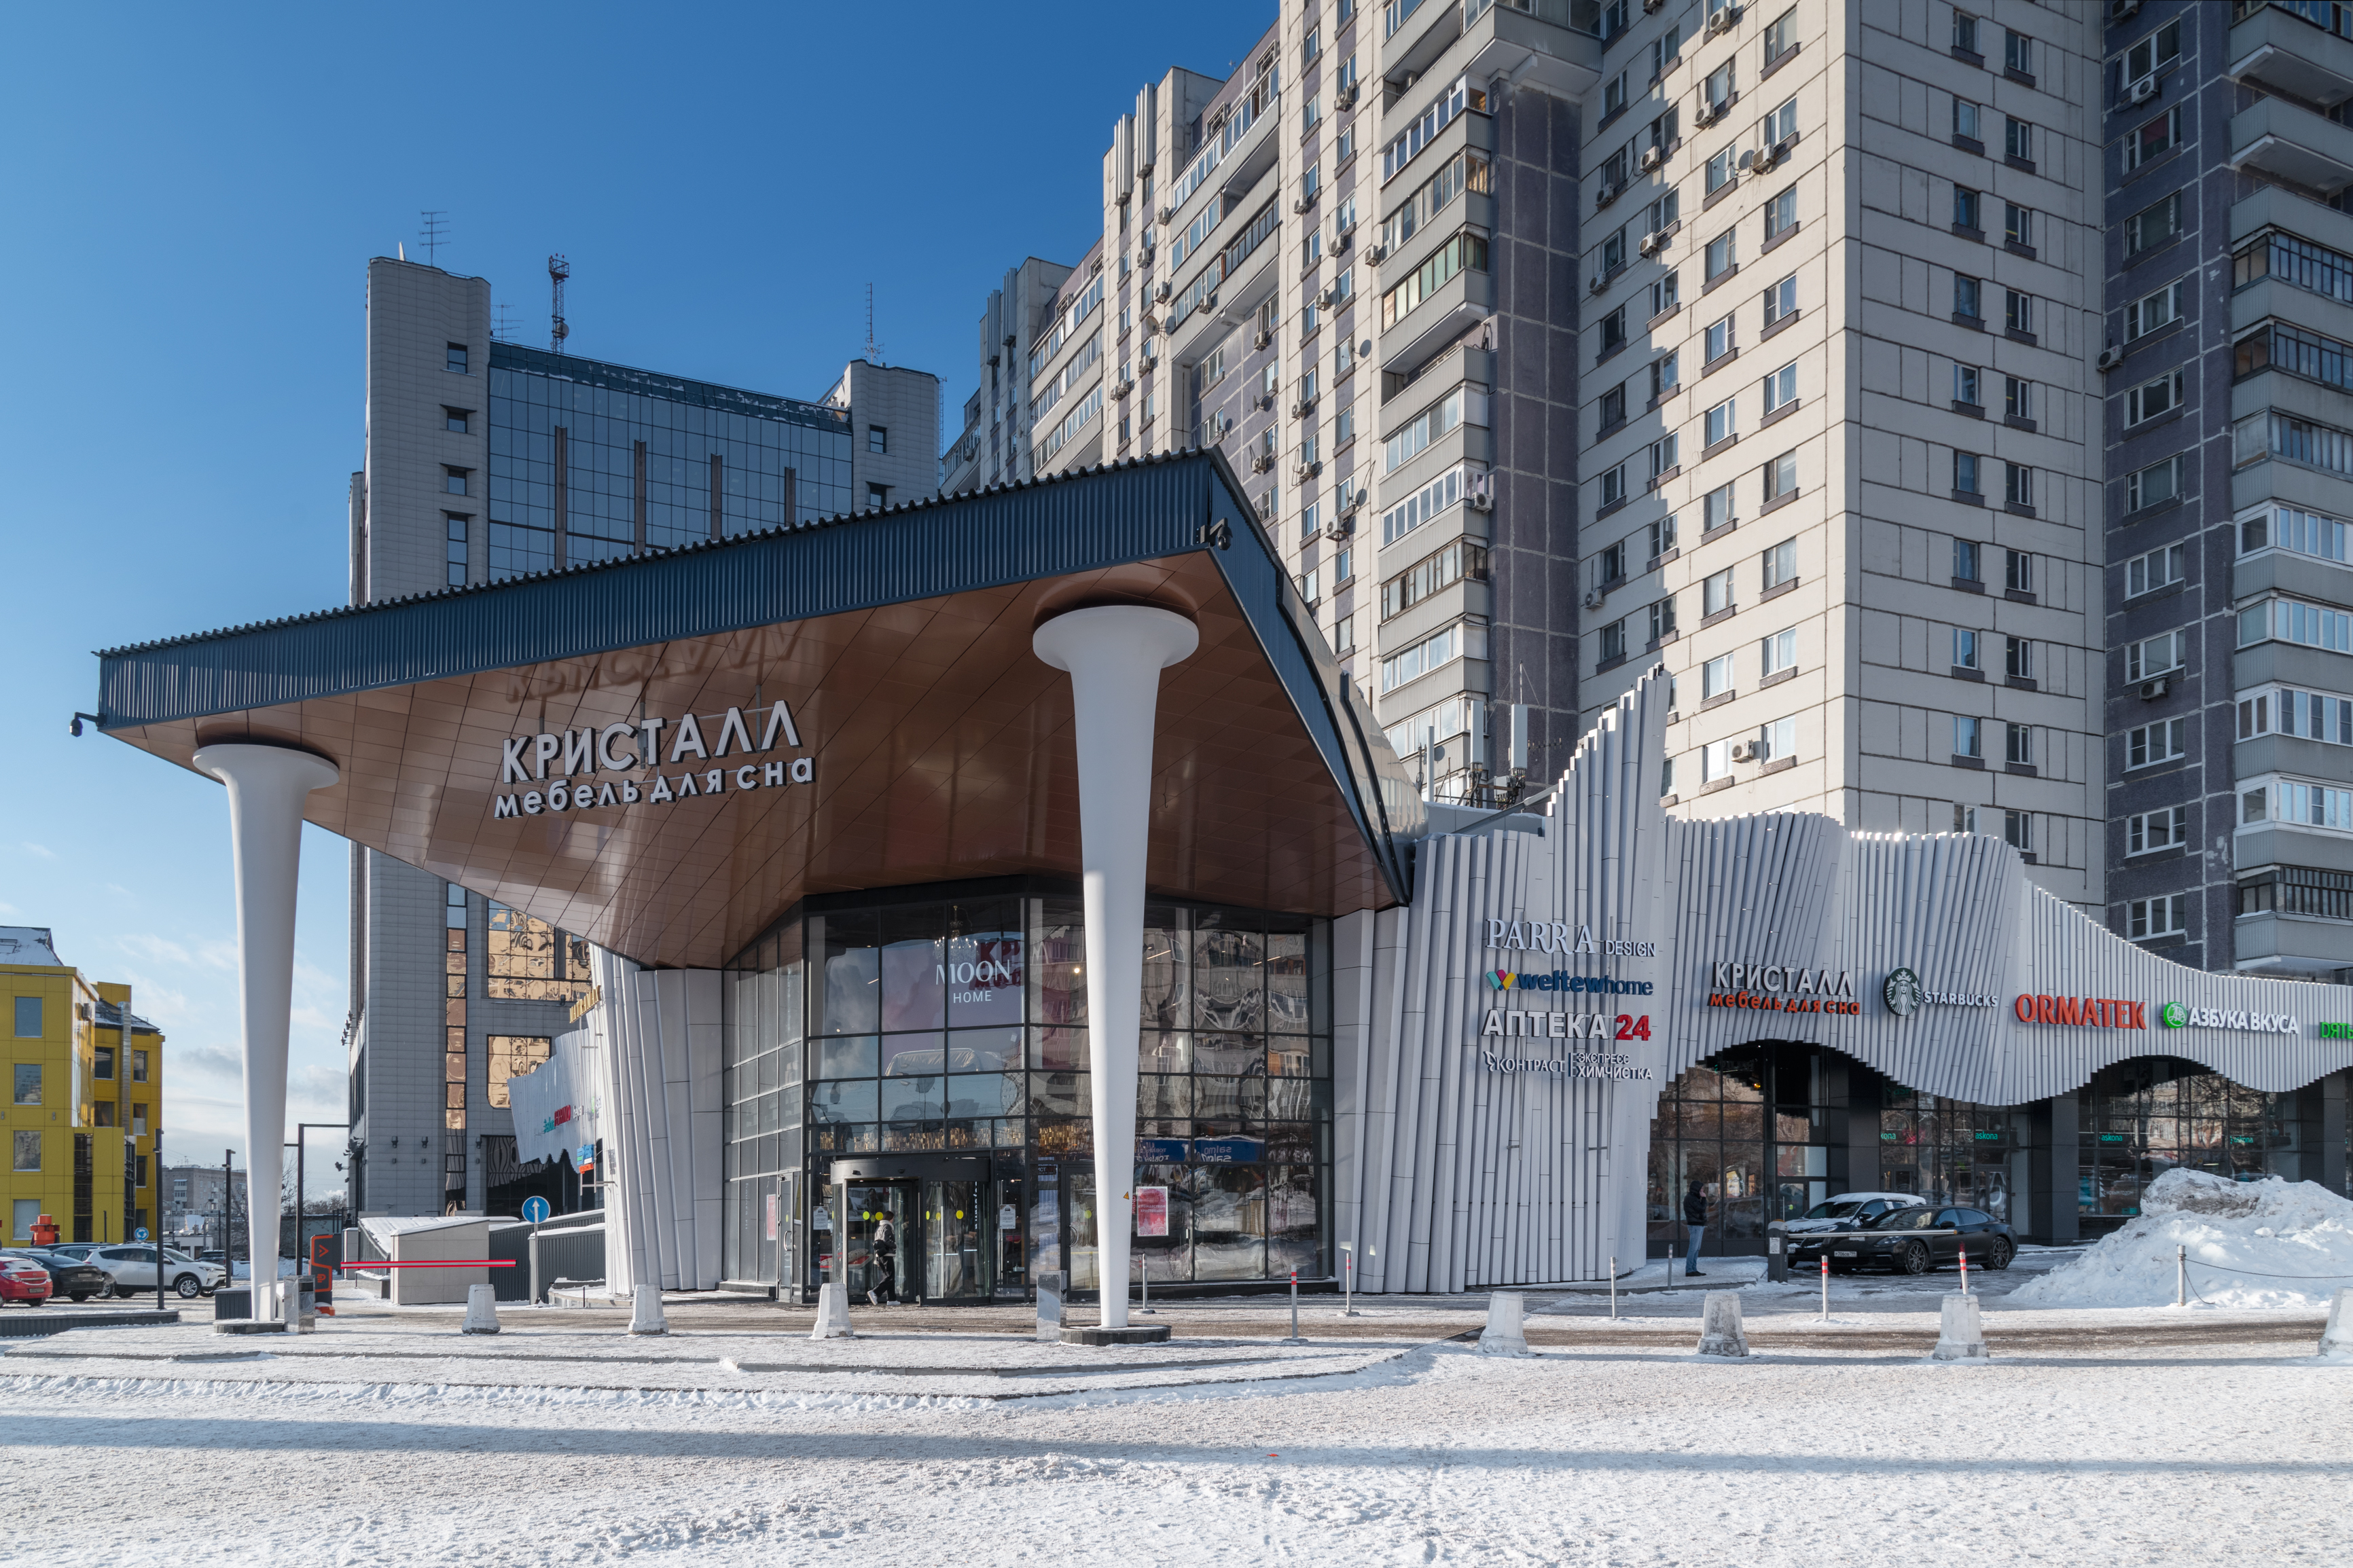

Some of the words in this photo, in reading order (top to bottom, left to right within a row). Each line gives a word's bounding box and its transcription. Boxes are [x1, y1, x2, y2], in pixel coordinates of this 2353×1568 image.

[503, 699, 803, 784] КРИСТАЛЛ
[494, 779, 642, 819] мебель
[650, 768, 725, 804] для
[736, 756, 816, 790] сна
[1485, 918, 1596, 955] PARRA
[1604, 940, 1656, 957] DESIGN
[935, 959, 1010, 985] MOON
[1712, 961, 1854, 996] КРИСТАЛЛ
[953, 990, 992, 1004] HOME
[1707, 990, 1782, 1010] мебель
[1784, 998, 1821, 1014] для
[1824, 999, 1861, 1015] сна
[1922, 990, 1998, 1008] STARBUCKS
[2015, 993, 2147, 1030] ORMATEK
[2188, 1007, 2249, 1030] АЗБУКА
[2249, 1012, 2300, 1034] ВКУСА
[1481, 1009, 1609, 1040] АПТЕКА
[1615, 1014, 1651, 1041] 24
[1495, 1057, 1566, 1074] КОНТРАСТ
[1576, 1053, 1630, 1064] ЭКСПРЕСС
[1575, 1065, 1653, 1080] ХИМЧИСТКА
[1975, 1131, 1998, 1140] askona
[2101, 1133, 2123, 1142] askona
